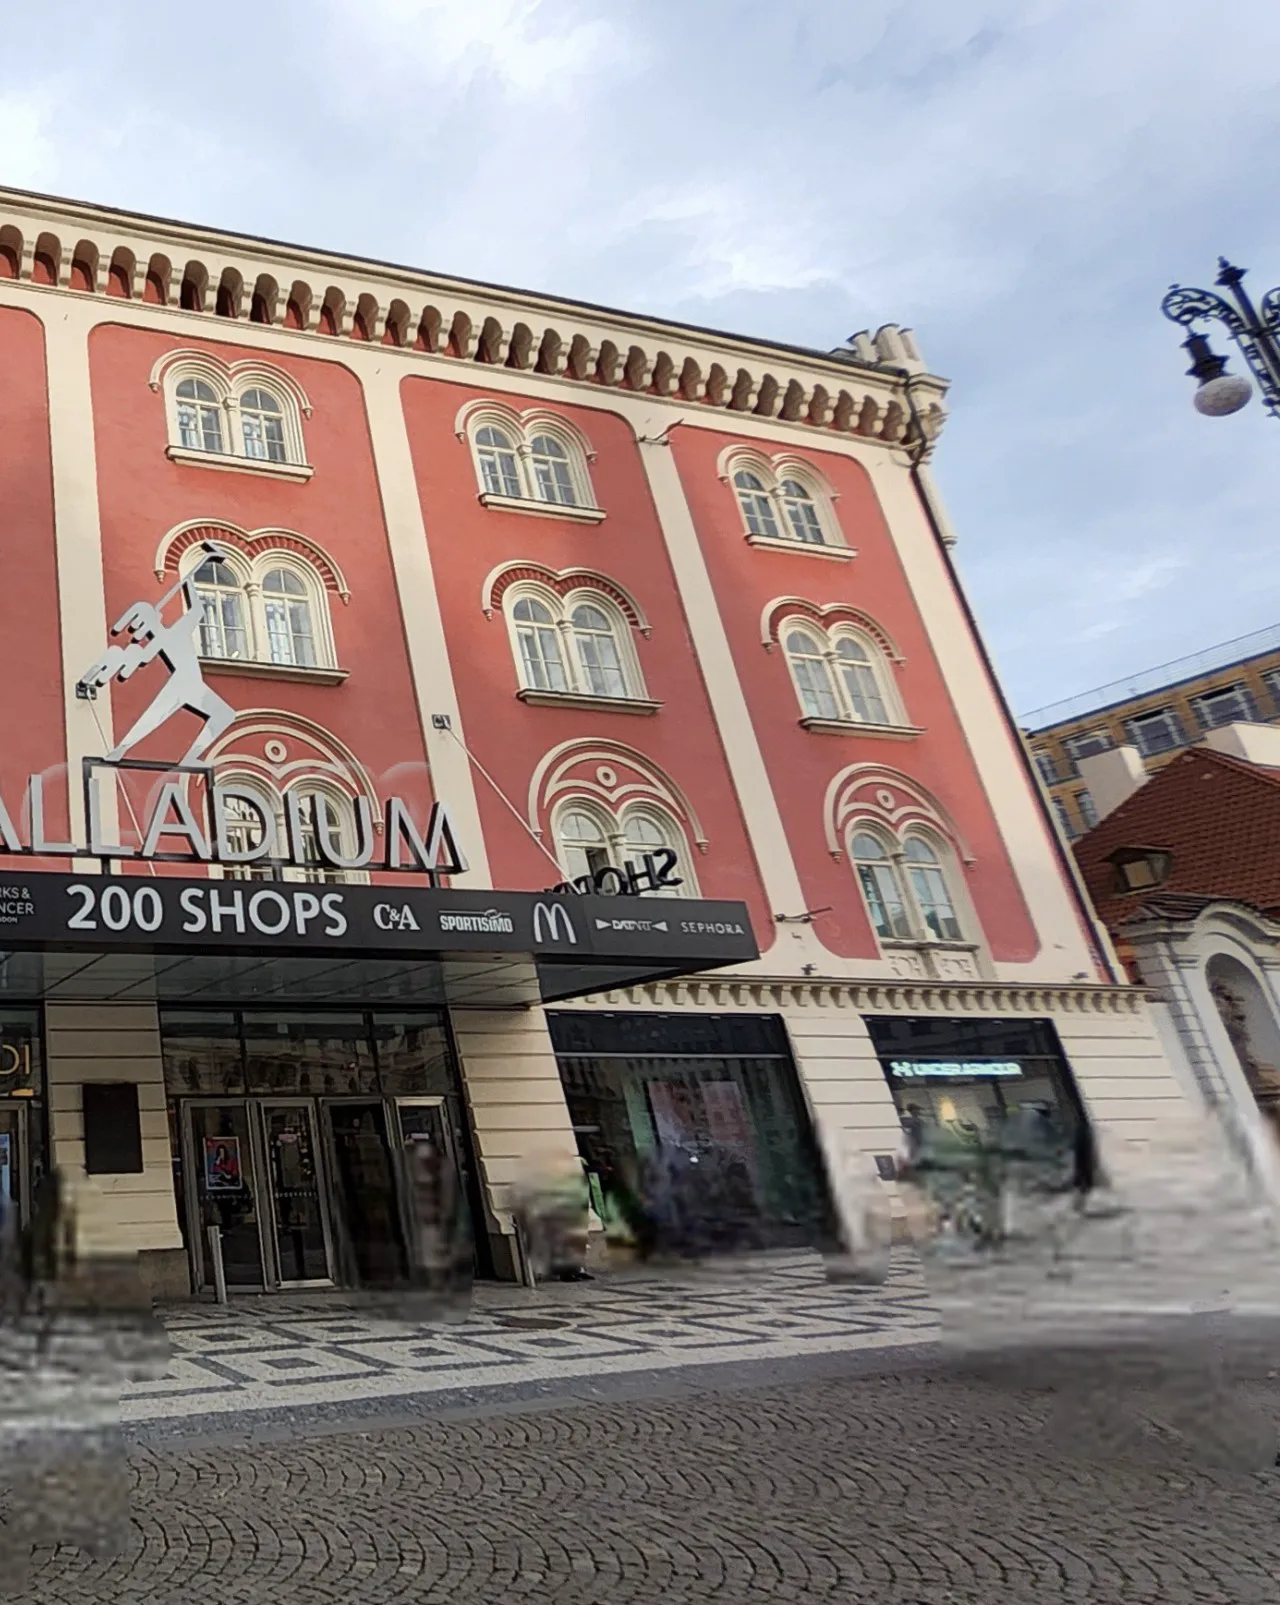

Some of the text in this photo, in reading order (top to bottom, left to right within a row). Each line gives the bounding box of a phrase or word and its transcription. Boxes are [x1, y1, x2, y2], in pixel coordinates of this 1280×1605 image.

[66, 884, 348, 937] 200 SHOPS
[373, 903, 421, 931] C&A
[439, 914, 514, 933] SPORTISIMO
[680, 922, 745, 935] SEPHORA
